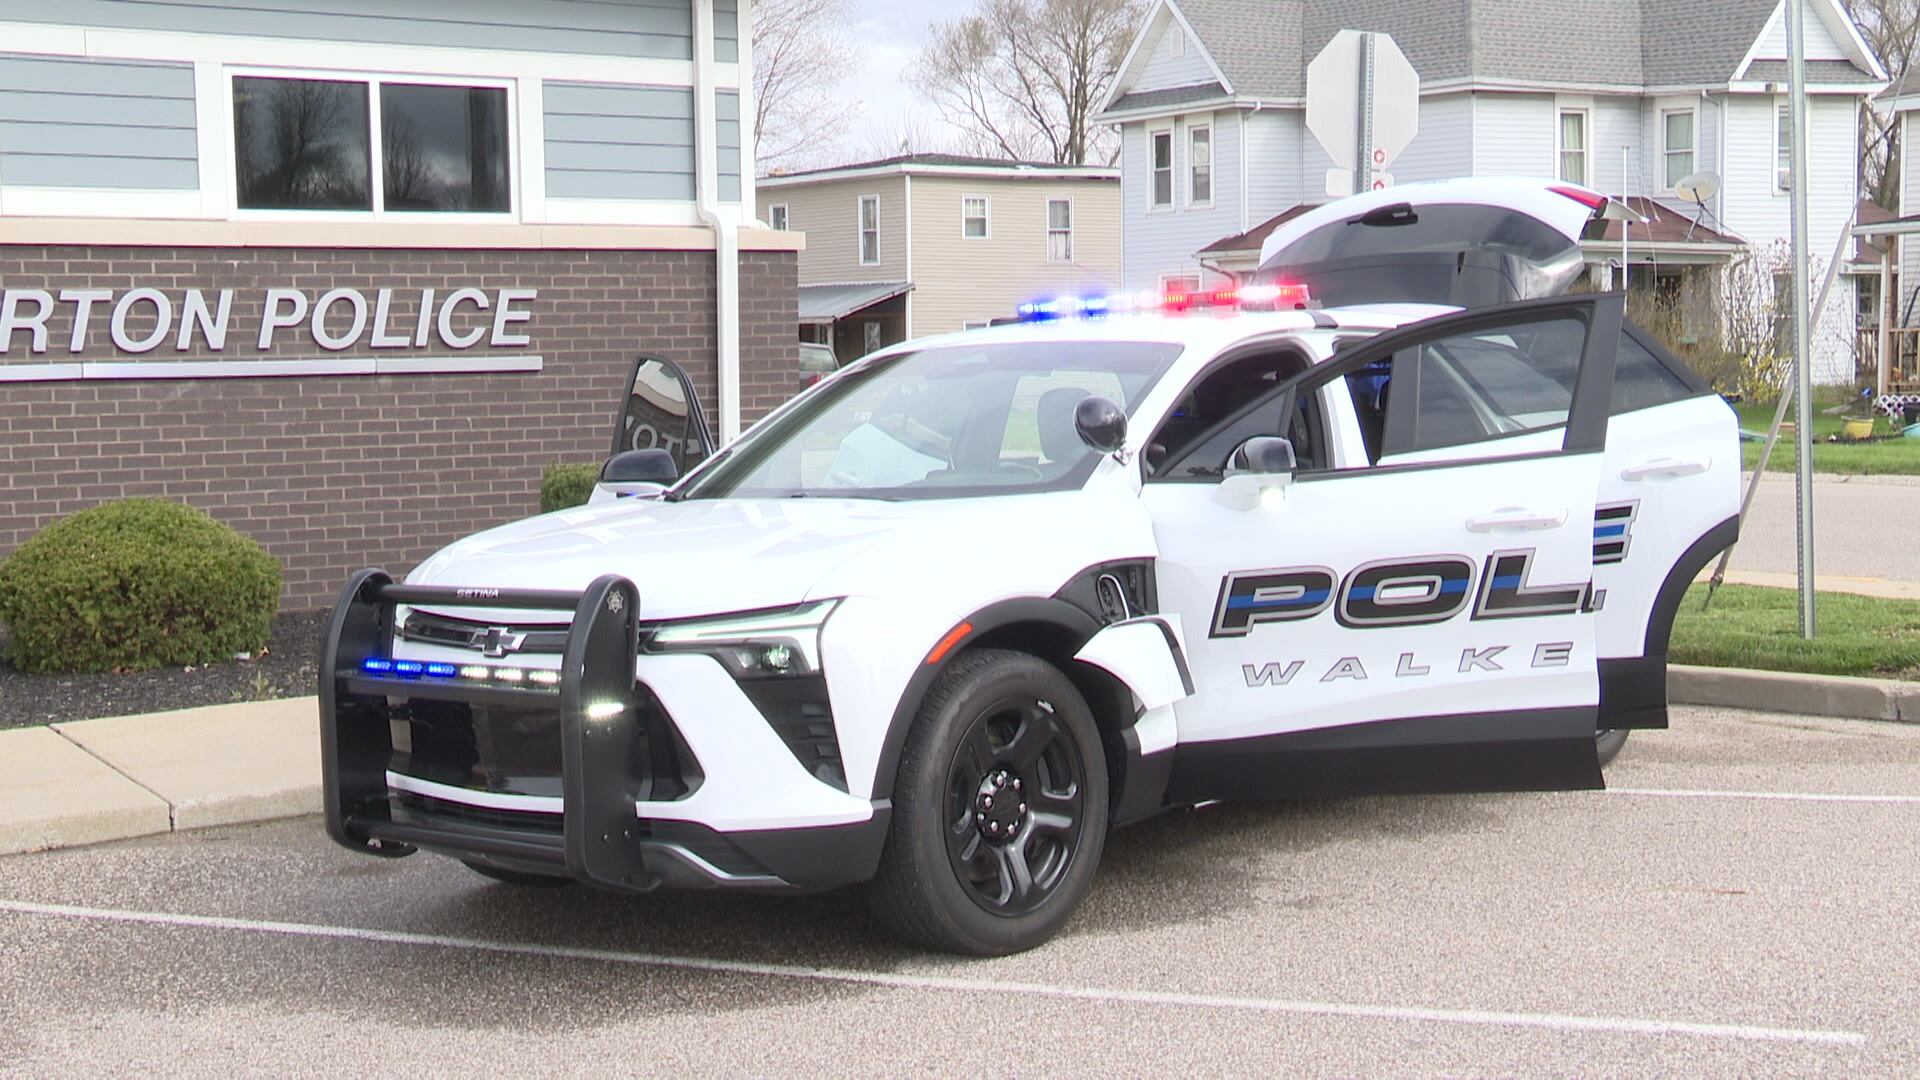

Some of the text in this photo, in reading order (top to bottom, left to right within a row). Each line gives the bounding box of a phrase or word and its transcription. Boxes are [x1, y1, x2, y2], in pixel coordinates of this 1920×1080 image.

[0, 287, 537, 353] RTON POLICE
[1208, 547, 1592, 639] POL
[1242, 641, 1574, 687] WALKE
